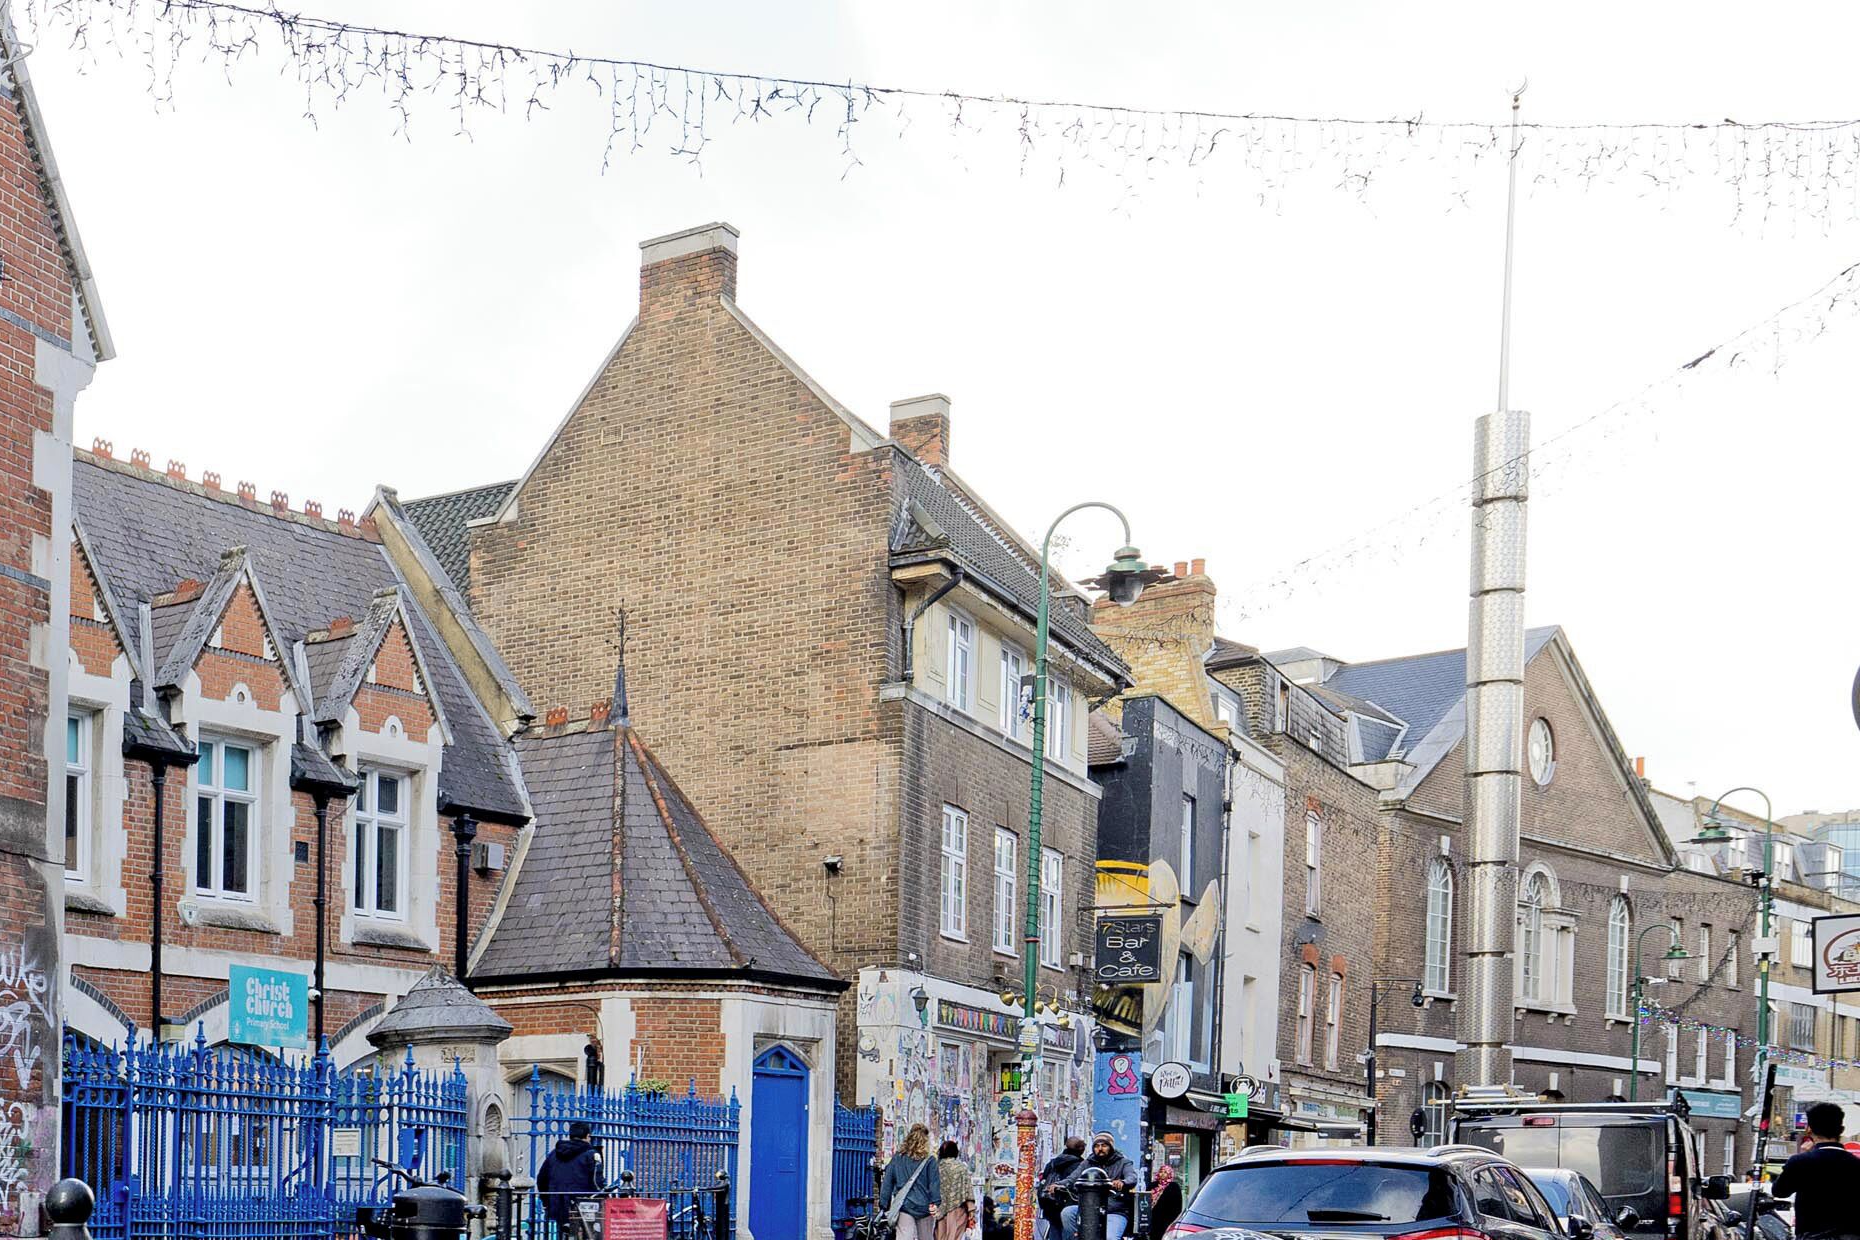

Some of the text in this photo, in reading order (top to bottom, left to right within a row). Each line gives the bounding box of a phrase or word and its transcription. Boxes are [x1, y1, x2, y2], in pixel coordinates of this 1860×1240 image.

[1106, 936, 1149, 949] Bar
[1119, 950, 1137, 963] &
[1099, 963, 1153, 978] Cafe
[246, 977, 291, 1001] Christ
[246, 998, 293, 1019] Church
[246, 1016, 290, 1031] Primary School
